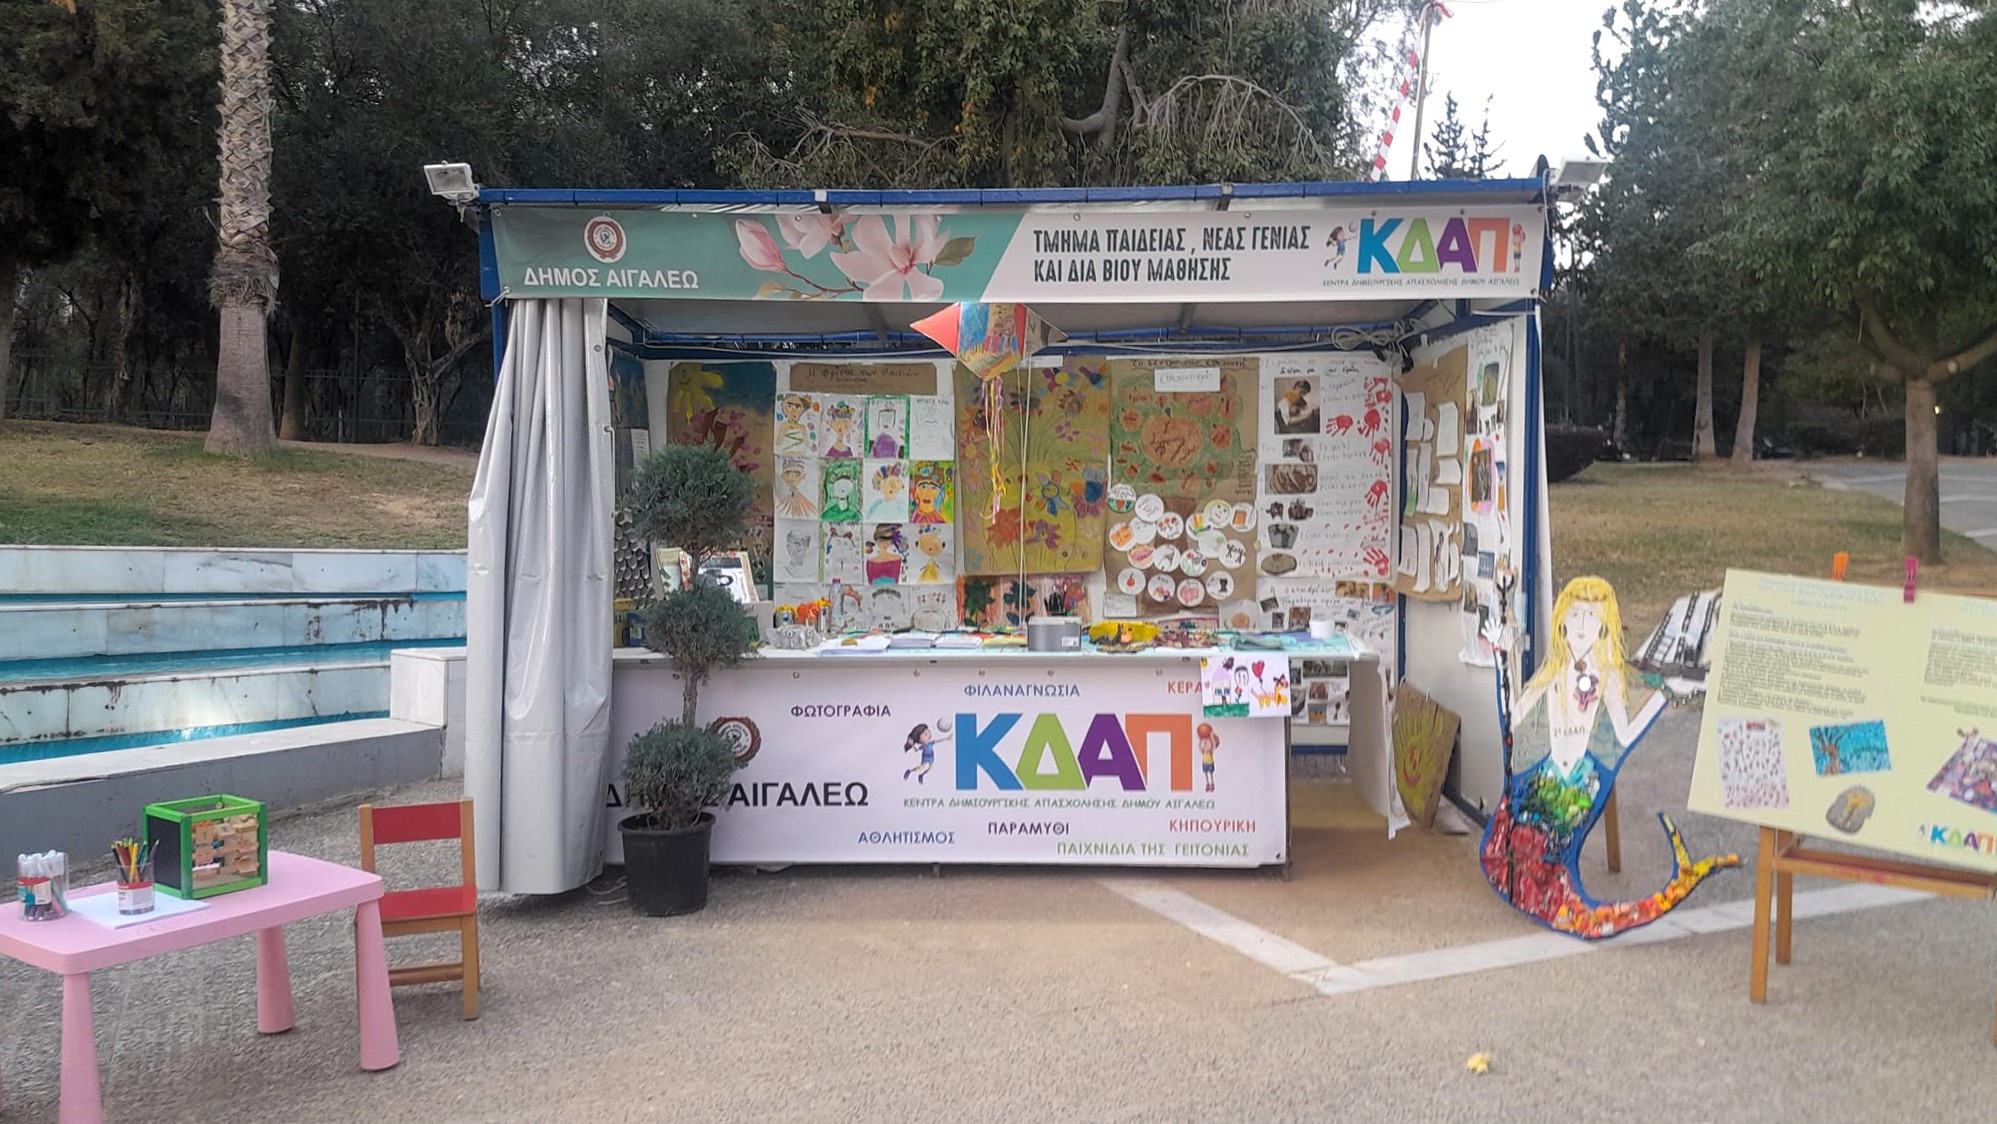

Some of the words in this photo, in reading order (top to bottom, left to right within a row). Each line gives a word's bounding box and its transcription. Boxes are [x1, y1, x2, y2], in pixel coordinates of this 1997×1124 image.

[1033, 228, 1101, 254] ΤΜΗΜΑ
[1202, 226, 1247, 251] ΝΕΑΣ
[1251, 225, 1311, 250] ΓΕΝΙΑΣ
[1357, 216, 1511, 274] ΚΔΑΠ
[523, 266, 601, 288] ΔΗΜΟΣ
[606, 267, 700, 290] ΑΙΓΑΛΕΩ
[1033, 259, 1065, 282] ΚΑΙ
[1068, 258, 1097, 282] ΔΙΑ
[1102, 258, 1142, 282] ΒΙΟΥ
[1147, 257, 1231, 282] ΜΑΘΗΣΗΣ
[963, 683, 1081, 698] ΦΙΛΑΝΑΓΝΩΣΙΑ
[1167, 681, 1202, 694] ΚΕΡΑ
[790, 704, 892, 718] ΦΩΤΟΓΡΑΦΙΑ
[955, 712, 1194, 792] ΚΔΑΠ
[728, 781, 869, 808] ΑΙΓΑΛΕΩ
[903, 797, 946, 808] ΚΕΝΤΡΑ
[949, 797, 1030, 808] ΔΗΜΙΟΥΡΓΙΚΗΣ
[1034, 798, 1118, 809] ΑΠΑΣΧΟΛΗΣΗΣ
[1121, 798, 1162, 809] ΔΗΜΟΥ
[1165, 798, 1216, 810] ΑΙΓΑΛΕΩ
[987, 822, 1070, 836] ΠΑΡΑΜΥΘΙ
[1169, 819, 1256, 834] ΚΗΠΟΥΡΙΚΗ
[858, 830, 955, 845] ΑΘΛΗΤΙΣΜΟΣ
[1930, 824, 1994, 854] ΚΔΑΠ
[1057, 841, 1136, 857] ΠΑΙΧΝΙΔΙΑ
[1140, 843, 1166, 857] ΤΗΣ
[1174, 843, 1250, 858] ΓΕΙΤΟΝΙΑΣ
